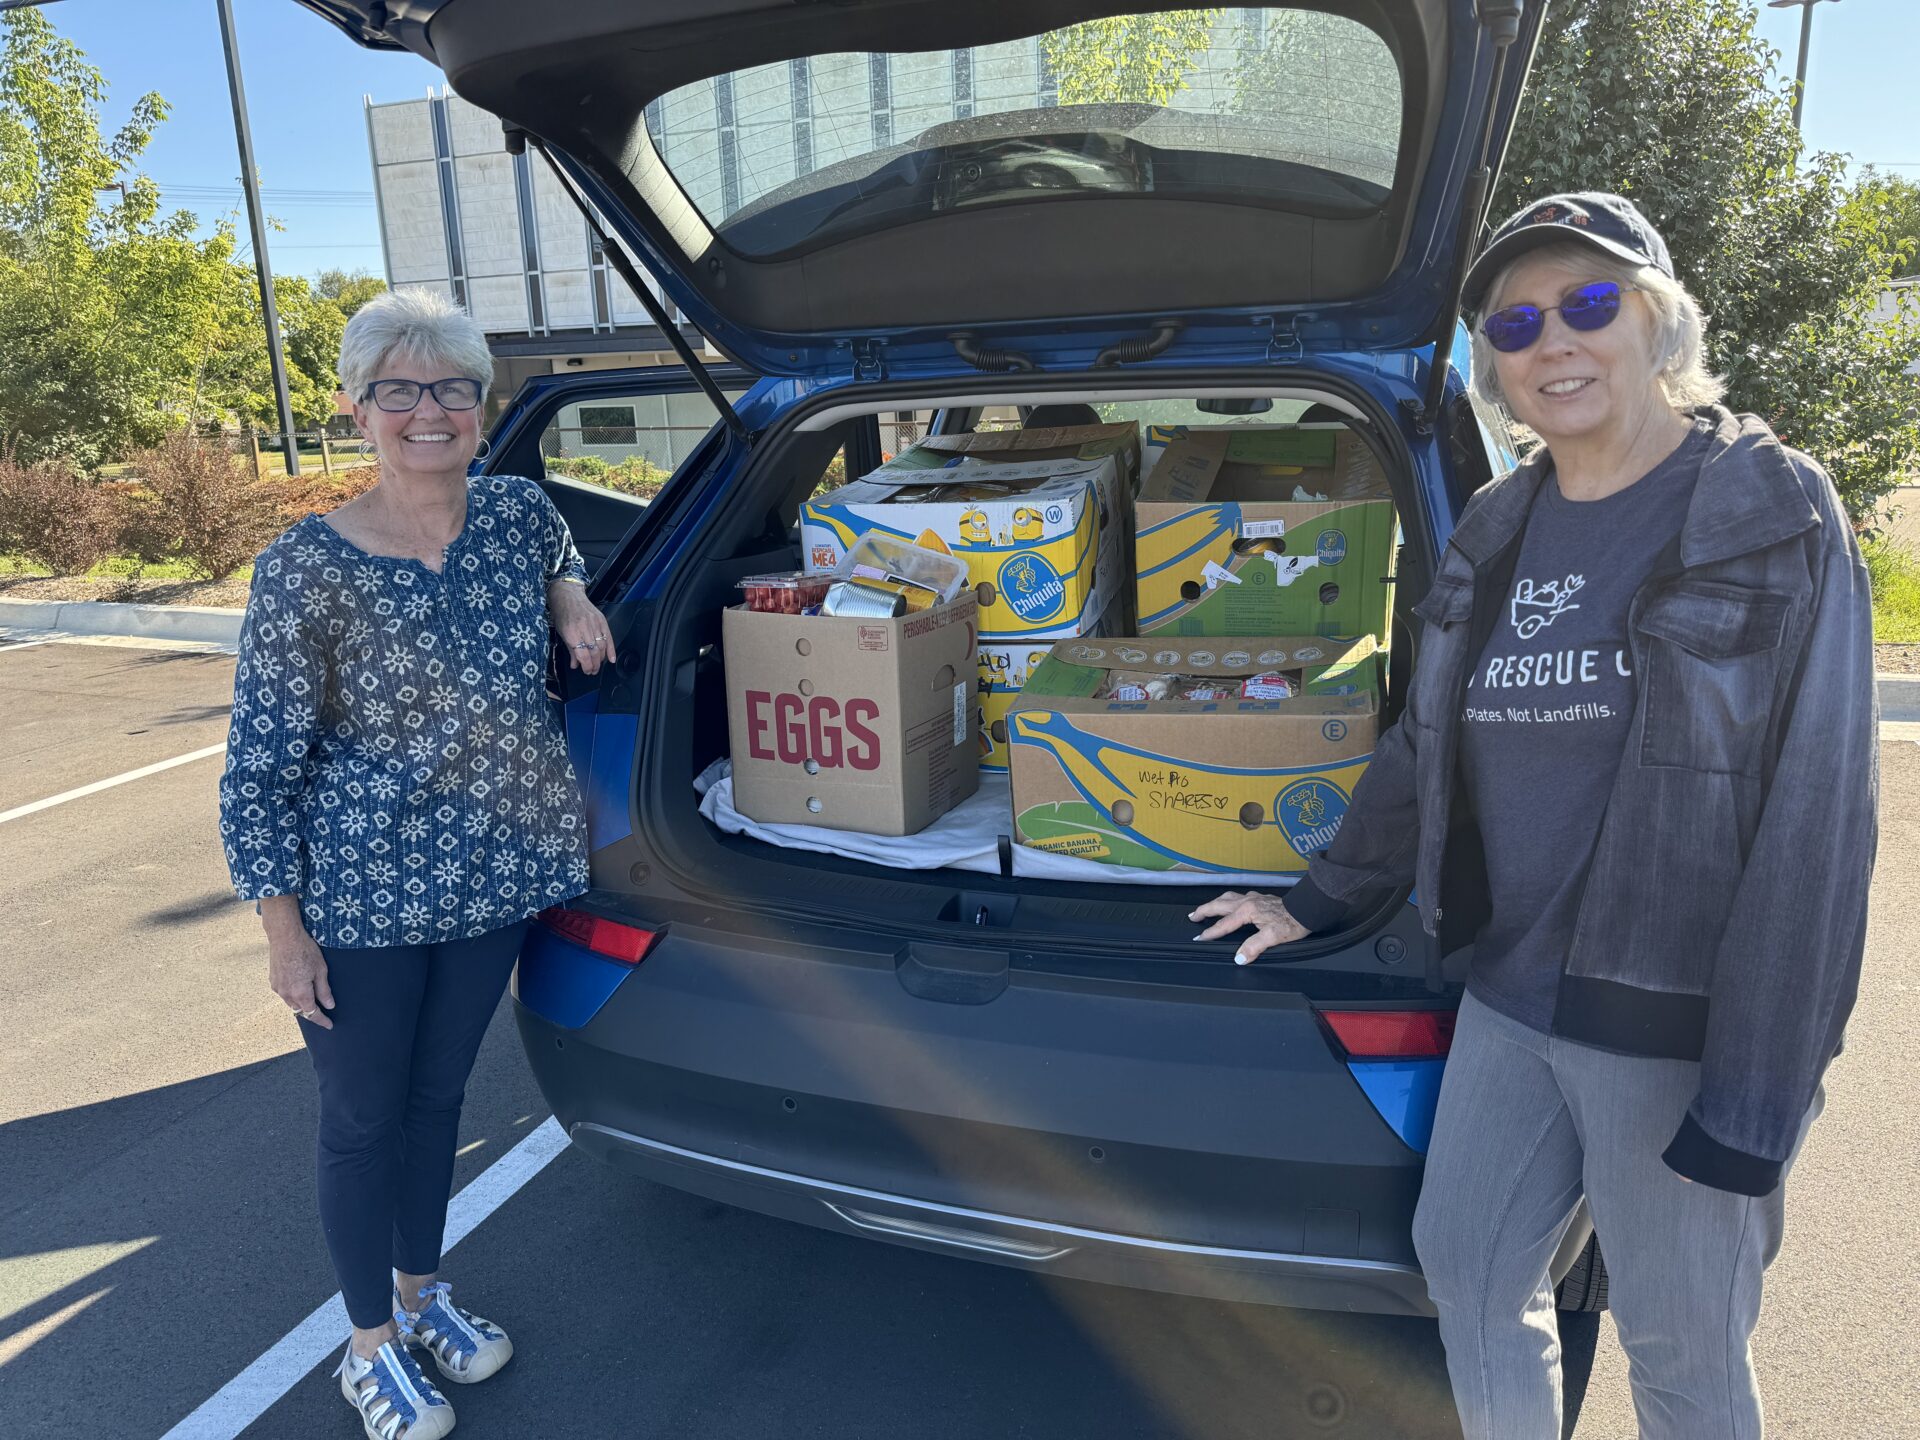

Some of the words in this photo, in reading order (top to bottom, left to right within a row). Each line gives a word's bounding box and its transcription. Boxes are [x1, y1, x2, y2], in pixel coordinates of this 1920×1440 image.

[1012, 580, 1064, 616] Chiquita
[1484, 650, 1599, 688] RESCUE
[1466, 708, 1505, 722] Plates.
[1507, 708, 1531, 722] Not
[1534, 702, 1616, 722] Landfills.
[745, 689, 881, 771] EGGS
[1139, 771, 1164, 784] Wet
[1066, 839, 1097, 848] BANANA
[1070, 845, 1101, 856] QUALITY
